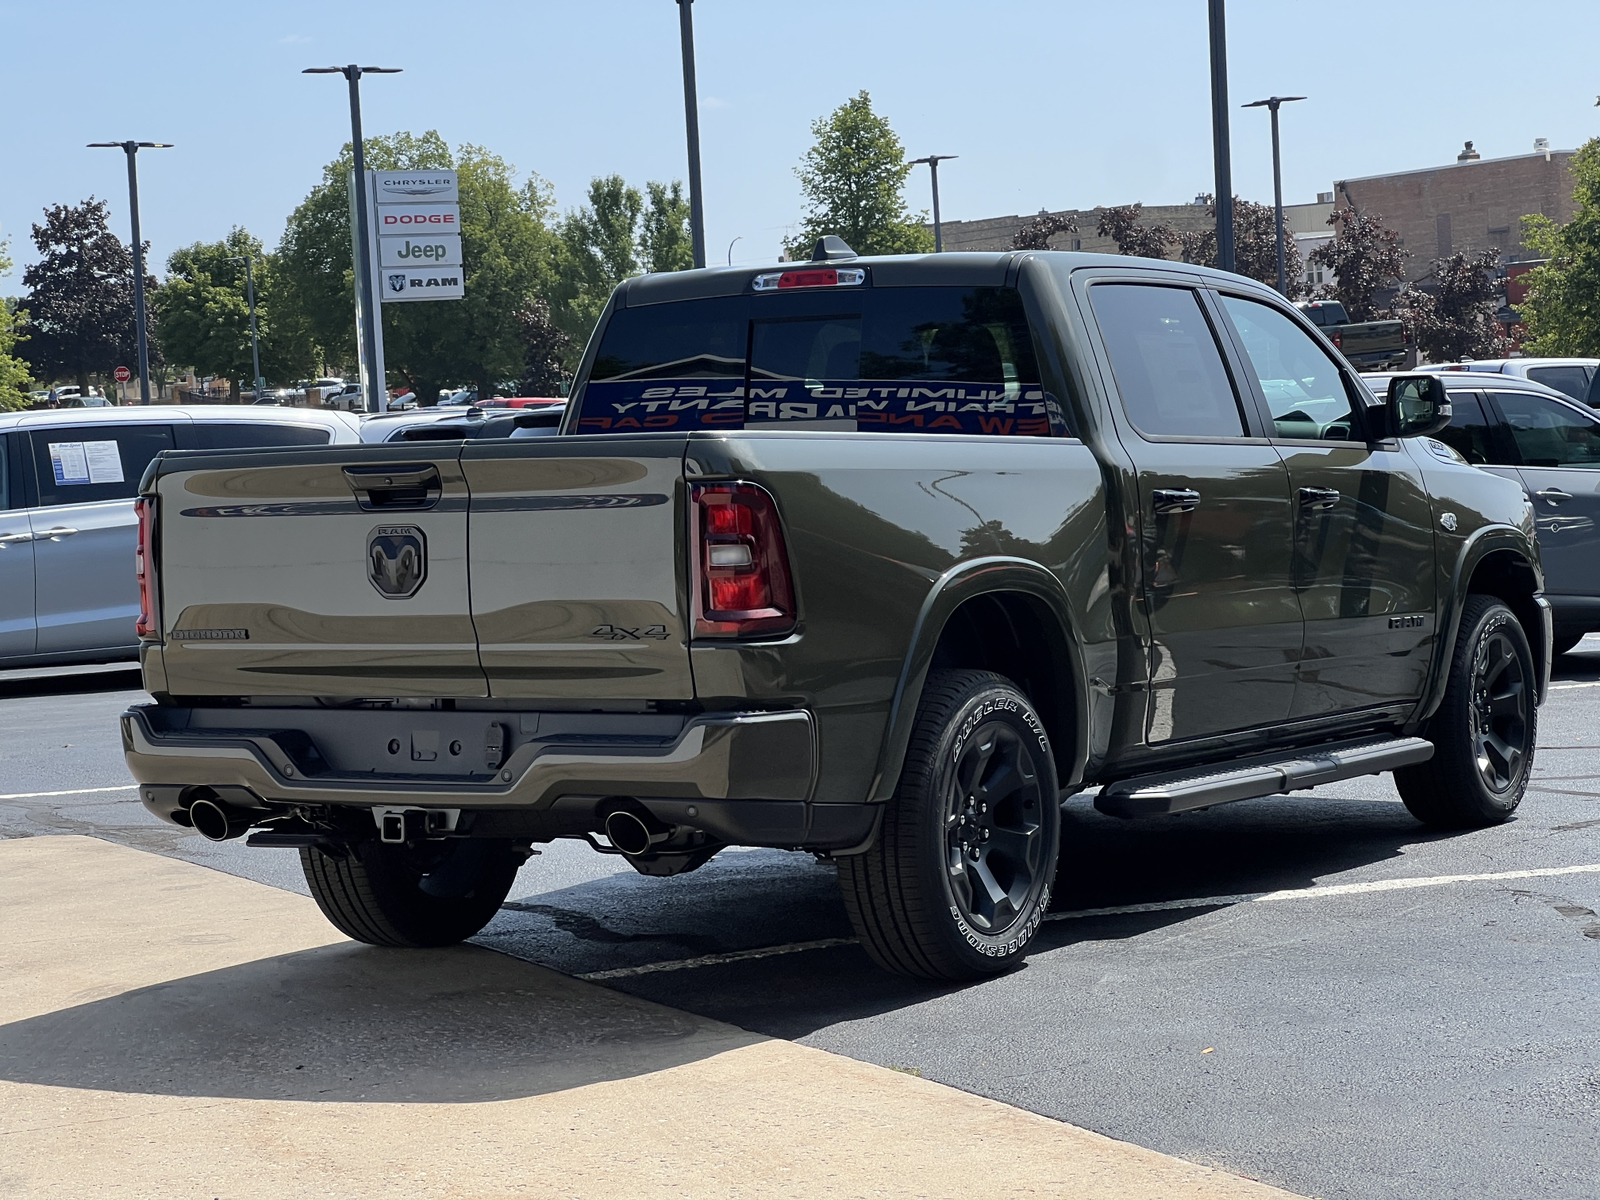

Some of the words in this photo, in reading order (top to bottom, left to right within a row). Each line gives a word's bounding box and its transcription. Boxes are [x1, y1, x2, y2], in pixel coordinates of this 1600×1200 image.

[384, 214, 455, 225] DODGE
[397, 240, 447, 261] Jeep
[409, 277, 459, 288] RAM
[1388, 615, 1425, 629] RAM
[588, 624, 671, 640] 4x4
[953, 697, 1019, 763] DUELER
[950, 883, 1050, 957] BRIDGESTONE
